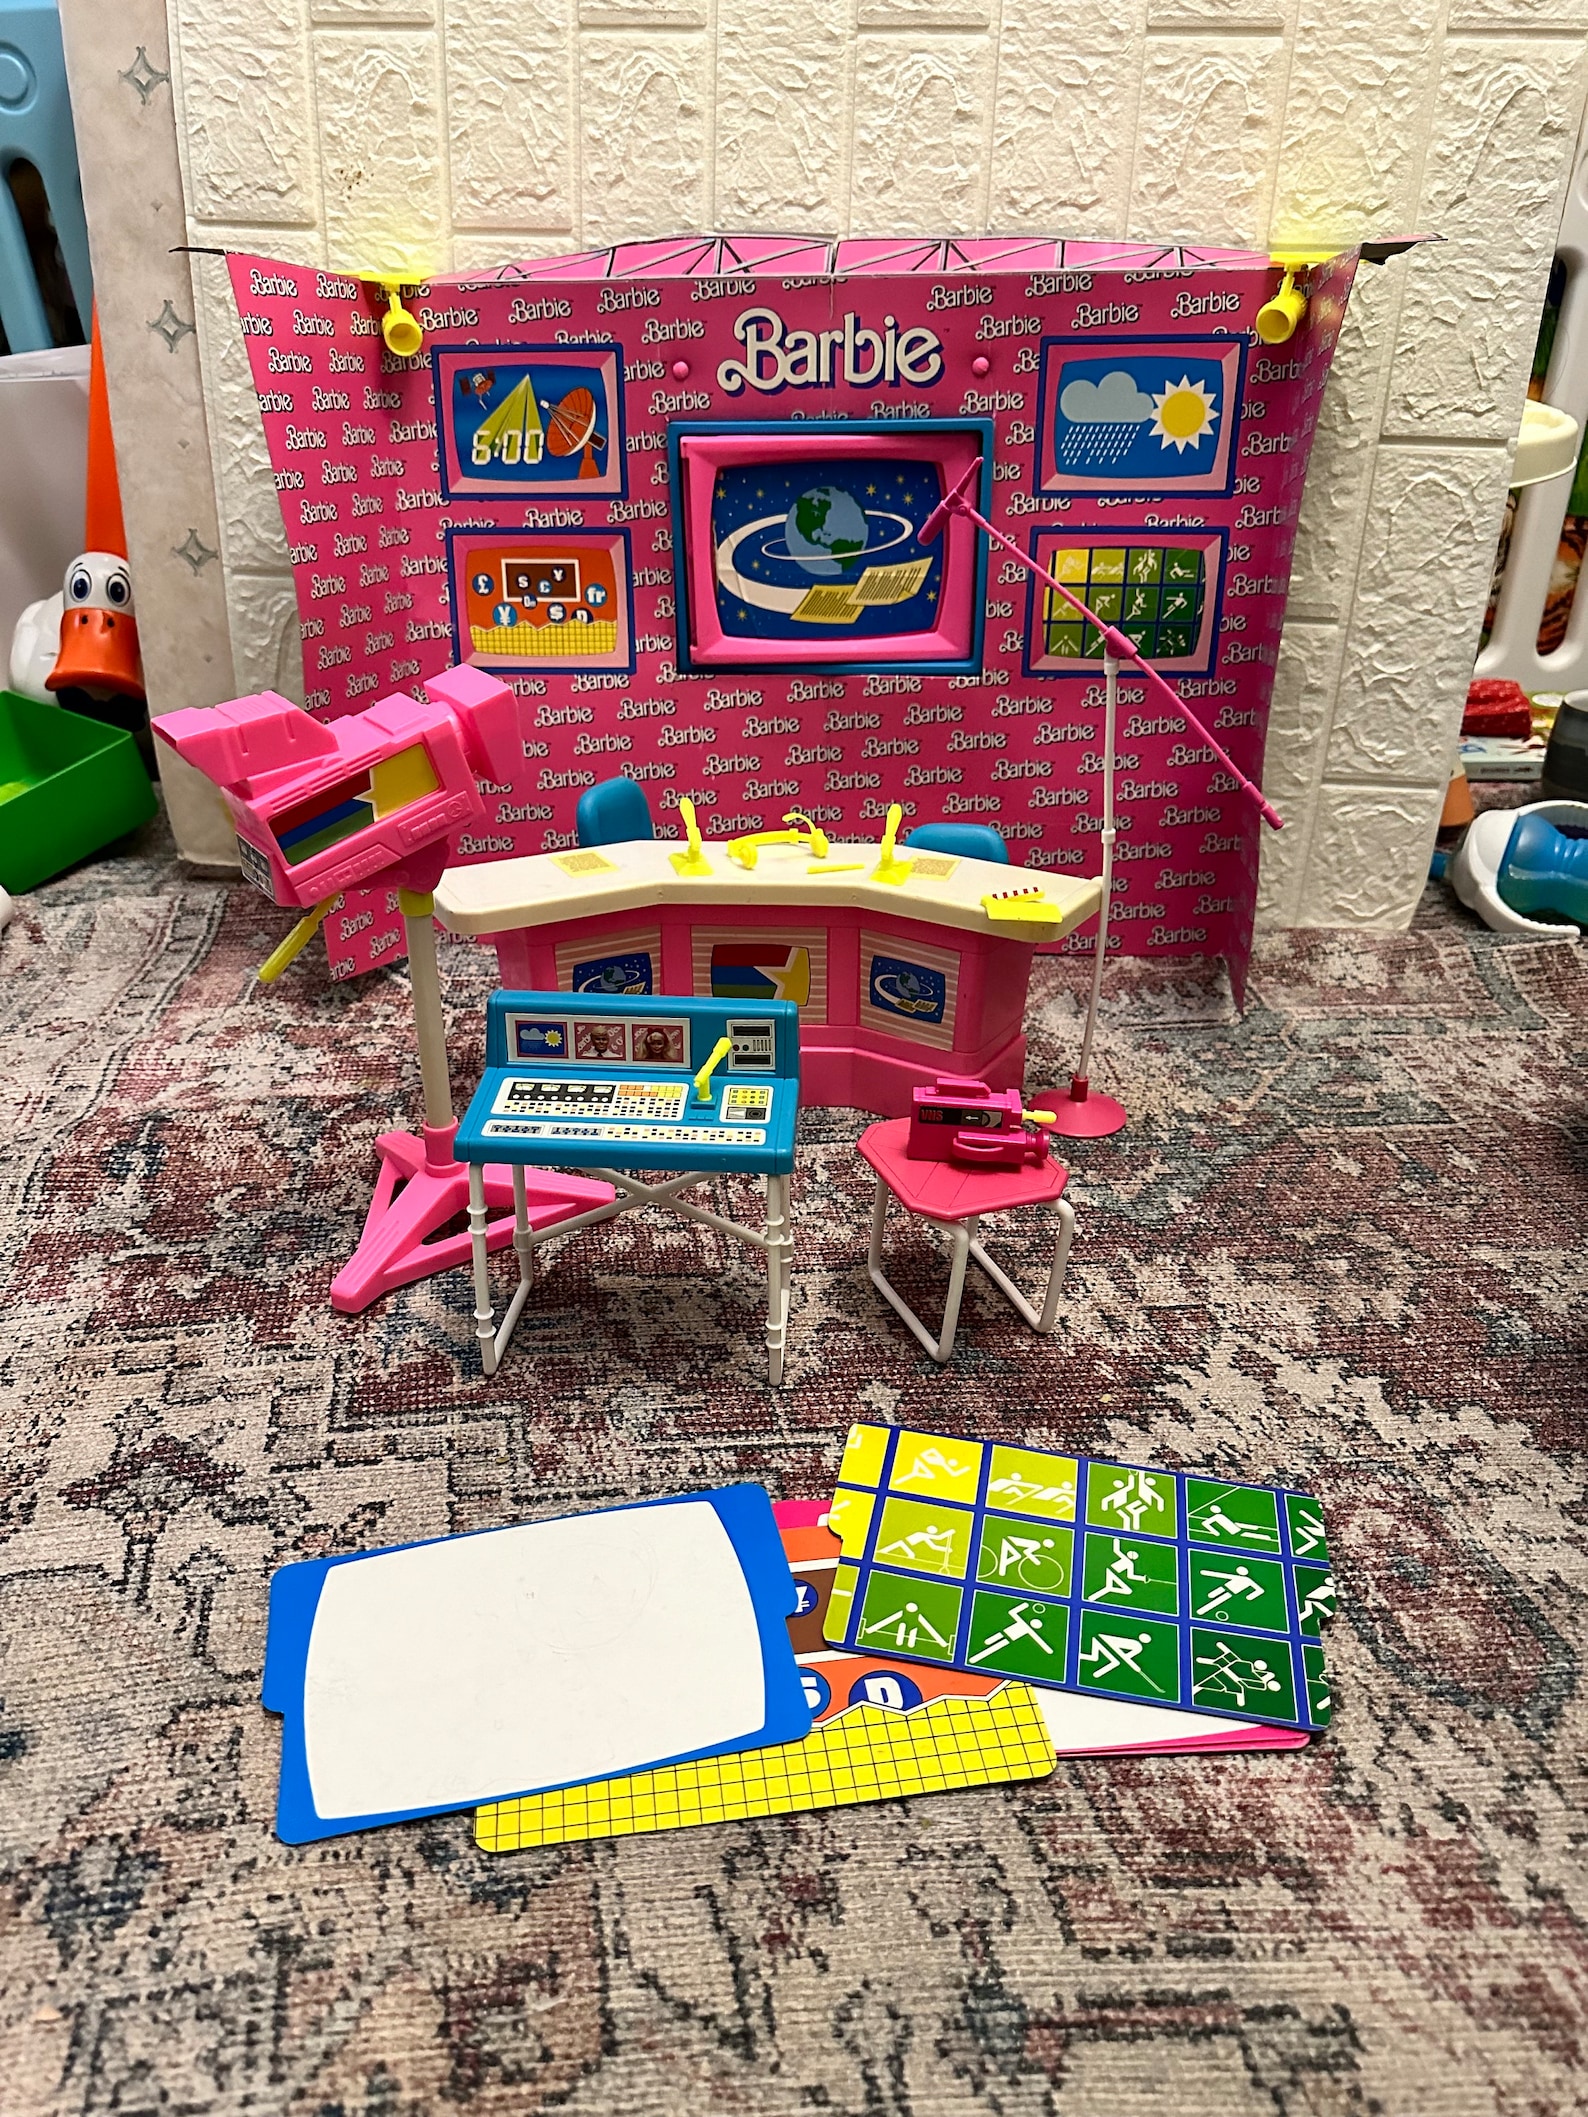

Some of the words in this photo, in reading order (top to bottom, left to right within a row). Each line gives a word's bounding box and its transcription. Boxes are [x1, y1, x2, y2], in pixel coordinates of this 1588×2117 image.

[250, 269, 298, 297] Barbie
[316, 273, 357, 300] Barbie
[597, 287, 660, 313] Barbie
[927, 285, 993, 311] Barbie
[1171, 291, 1240, 318] Barbie
[293, 309, 335, 336] Barbie
[508, 298, 572, 324] Barbie
[1071, 303, 1139, 329] Barbie
[642, 318, 705, 344] Barbie
[976, 315, 1041, 340] Barbie
[268, 347, 312, 373] Barbie
[329, 348, 364, 373] Barbie
[716, 307, 942, 392] Barbie
[623, 359, 666, 382] arbie
[257, 388, 293, 412] arbie
[312, 386, 350, 411] Barbie
[648, 390, 711, 415] Barbie
[960, 390, 1024, 415] Barbie
[286, 425, 326, 450] Barbie
[342, 422, 376, 446] Barbie
[389, 420, 438, 443] Barbi
[626, 431, 668, 452] arbie
[472, 430, 544, 465] 6:00
[322, 460, 357, 484] Barbie
[371, 455, 404, 478] Barbie
[301, 500, 338, 525] Barbie
[352, 494, 383, 517] Barbie
[607, 499, 668, 523] Barbie
[334, 533, 367, 557] Barbie
[379, 526, 410, 548] Barbie
[290, 542, 318, 565] arbie
[311, 574, 346, 599] Barbie
[632, 567, 673, 587] arbie
[340, 604, 372, 628] Barbie
[318, 646, 351, 670] Barbie
[347, 674, 378, 698] Barbie
[786, 680, 845, 703] Barbie
[862, 675, 922, 696] Barbie
[617, 697, 676, 720] Barbie
[704, 688, 763, 711] Barbie
[990, 695, 1053, 717] Barbie
[533, 704, 594, 727] Barbie
[823, 711, 881, 732] Barbie
[903, 704, 963, 725] Barbie
[657, 724, 716, 747] Barbie
[742, 716, 800, 738] Barbie
[1033, 722, 1095, 745] Barbie
[1123, 715, 1186, 738] Barbie
[573, 732, 632, 755] Barbie
[861, 736, 919, 758] Barbie
[946, 730, 1006, 752] Barbie
[702, 753, 761, 776] Barbie
[784, 743, 842, 766] Barbie
[536, 767, 596, 790] Barbie
[824, 770, 881, 792] Barbie
[903, 766, 963, 787] Barbie
[990, 759, 1052, 780] Barbie
[742, 779, 799, 801] Barbie
[1028, 786, 1089, 808] Barbie
[1117, 780, 1178, 801] Barbie
[495, 802, 553, 823] Barbie
[942, 793, 1001, 814] Barbie
[706, 813, 763, 835] Barbie
[1159, 805, 1221, 827] Barbie
[458, 833, 514, 854] Barbie
[1112, 840, 1172, 862] Barbie
[1024, 847, 1084, 867] Barbie
[1155, 869, 1216, 890] Barbie
[1147, 925, 1207, 946] Barbie
